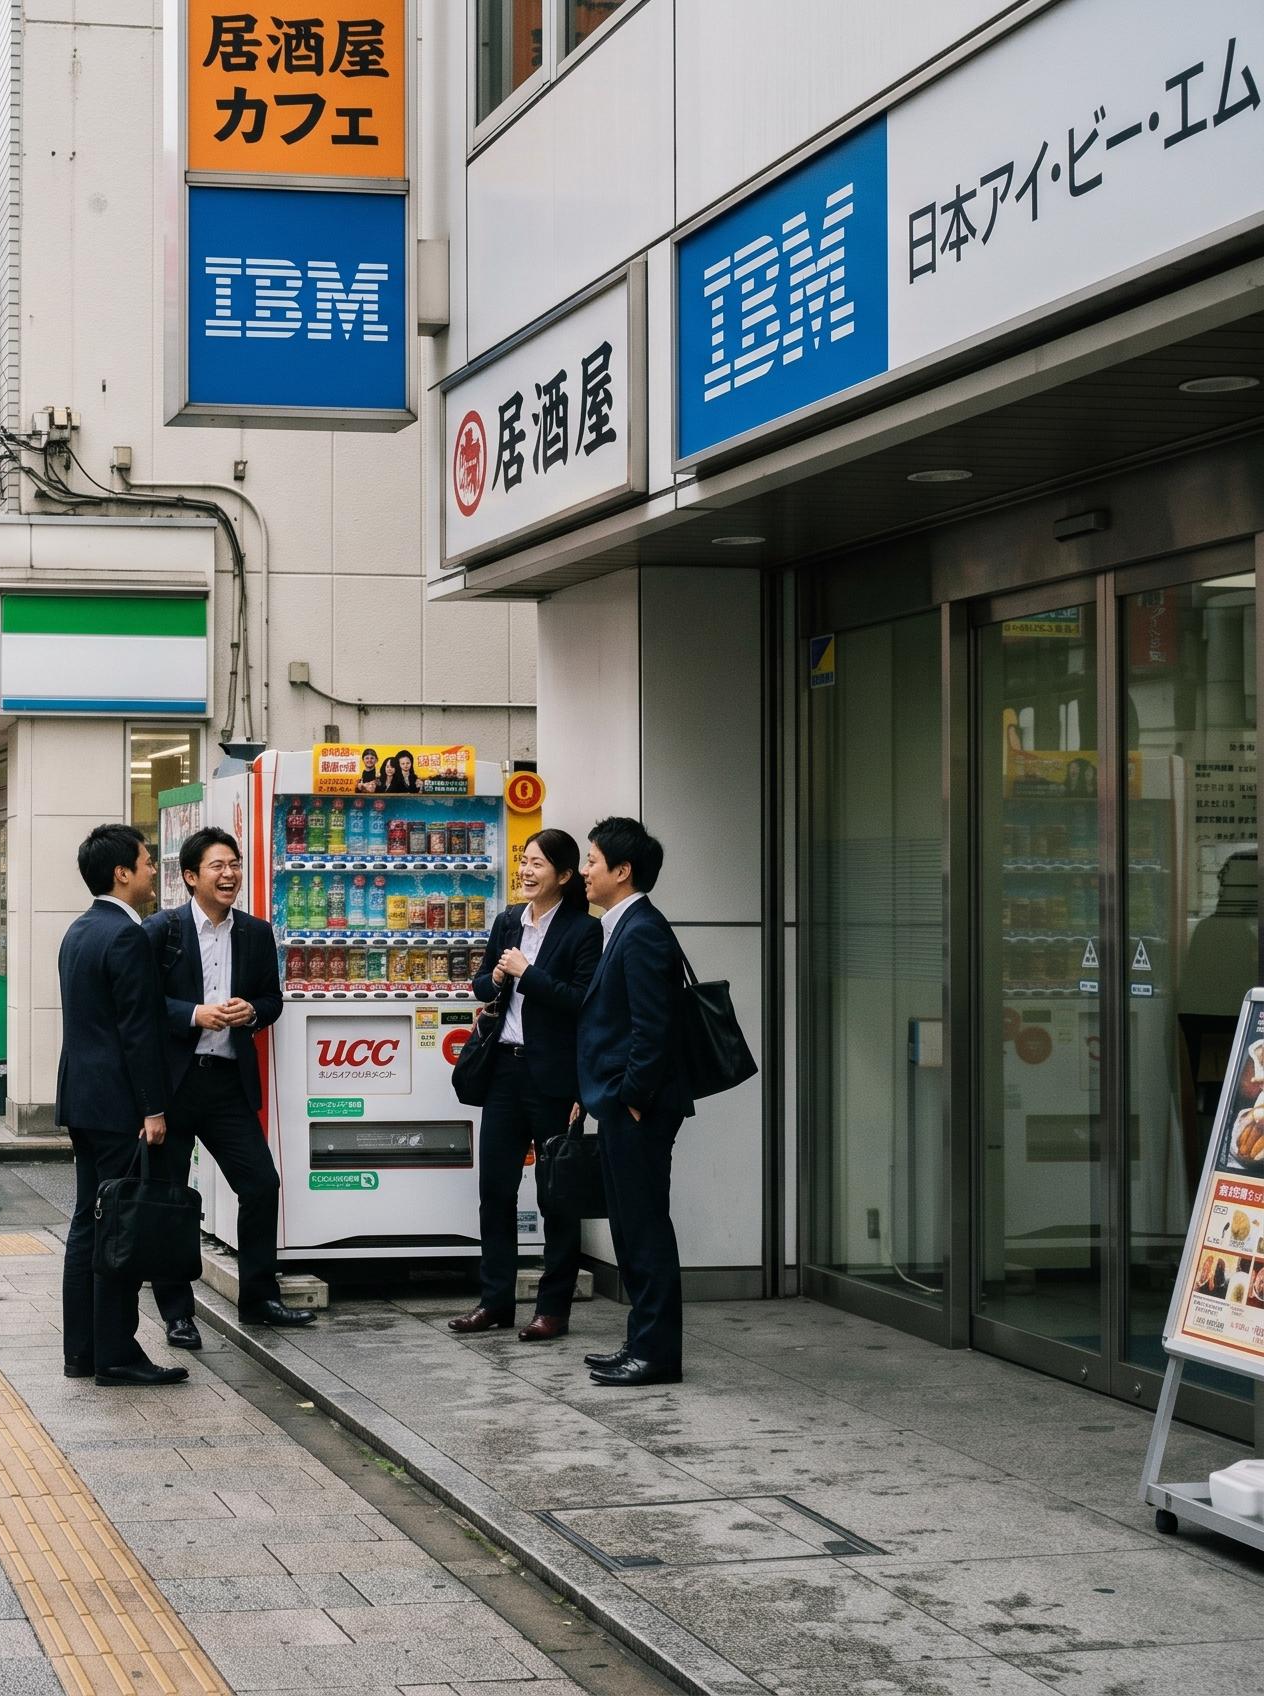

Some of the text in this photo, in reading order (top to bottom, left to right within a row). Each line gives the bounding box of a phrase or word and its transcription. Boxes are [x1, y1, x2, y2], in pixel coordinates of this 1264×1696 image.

[203, 14, 389, 78] 居酒屋
[214, 87, 379, 146] カフェ
[205, 256, 388, 341] IBM
[704, 182, 854, 402] IBM
[492, 341, 617, 494] 居酒屋
